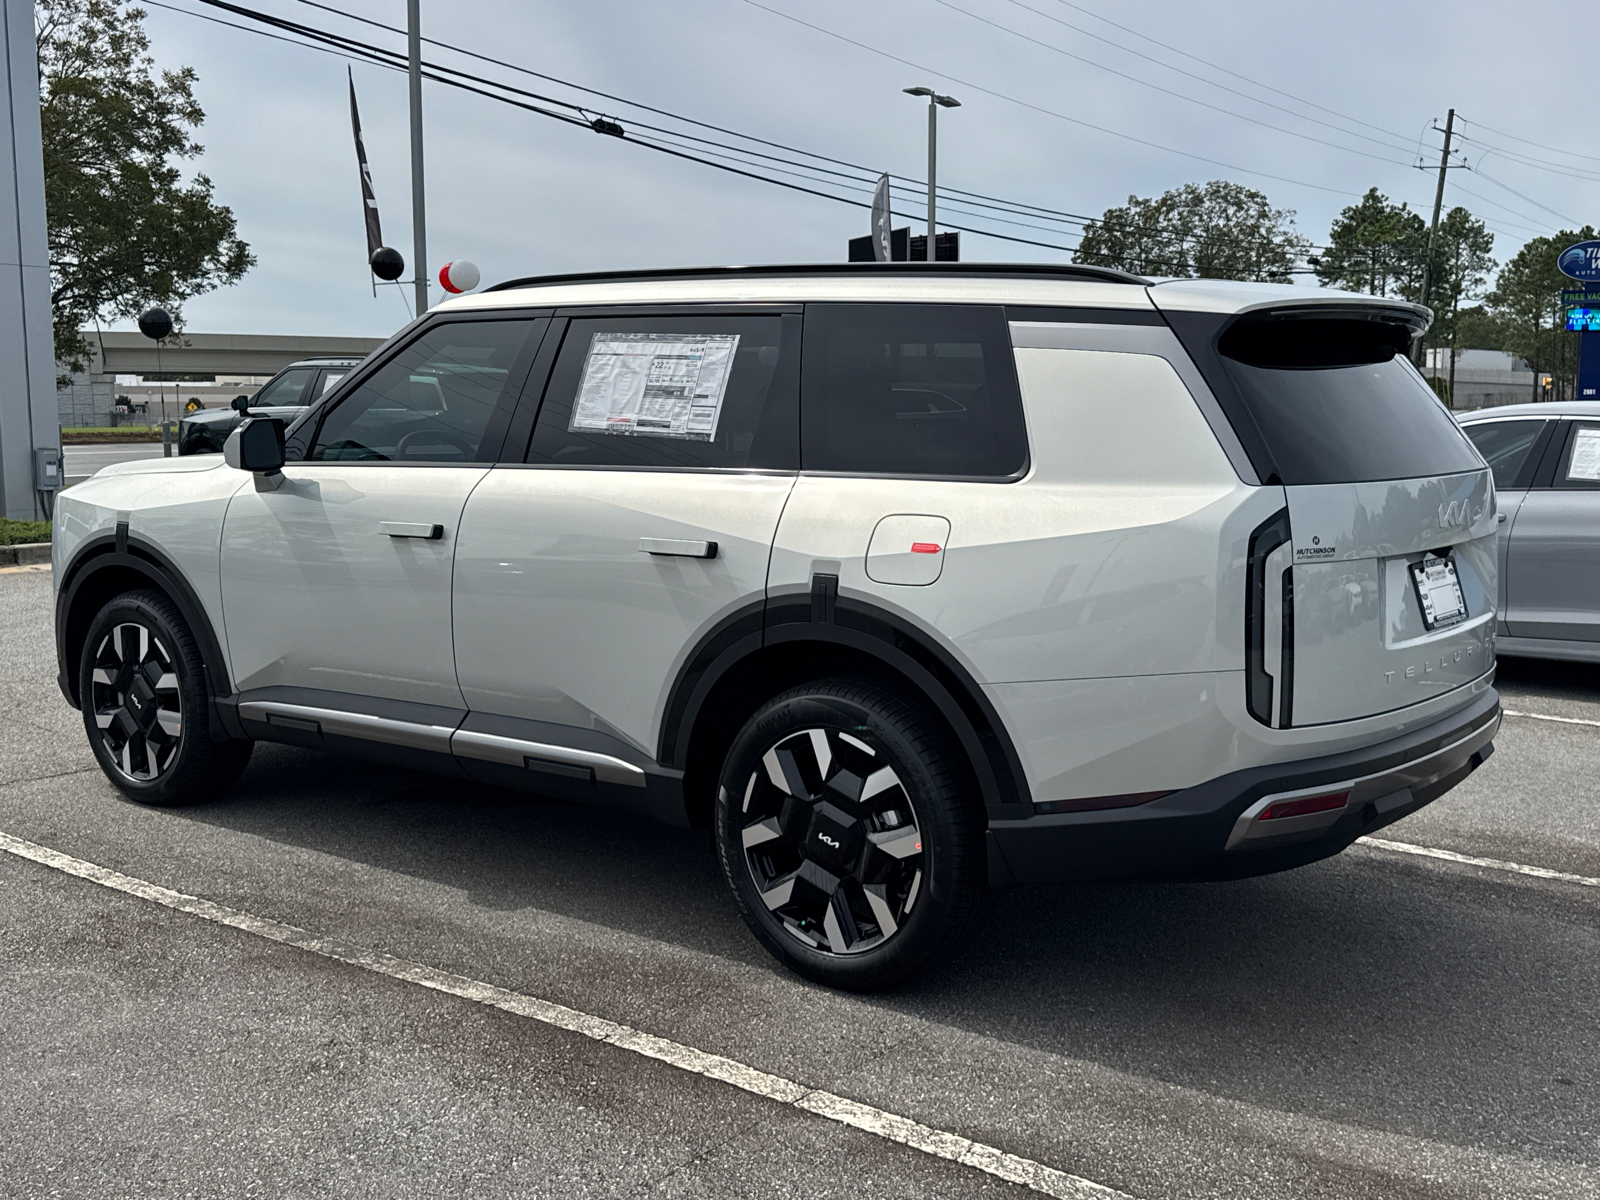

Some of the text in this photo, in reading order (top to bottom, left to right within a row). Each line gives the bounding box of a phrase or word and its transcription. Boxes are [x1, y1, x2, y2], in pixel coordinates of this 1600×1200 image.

[1564, 293, 1585, 301] FREE
[655, 361, 664, 369] 22
[1438, 498, 1472, 528] KIA
[1296, 546, 1336, 555] HUTCHINSON
[131, 693, 142, 710] KIA
[818, 832, 840, 849] KIA
[719, 842, 756, 929] CORPION
